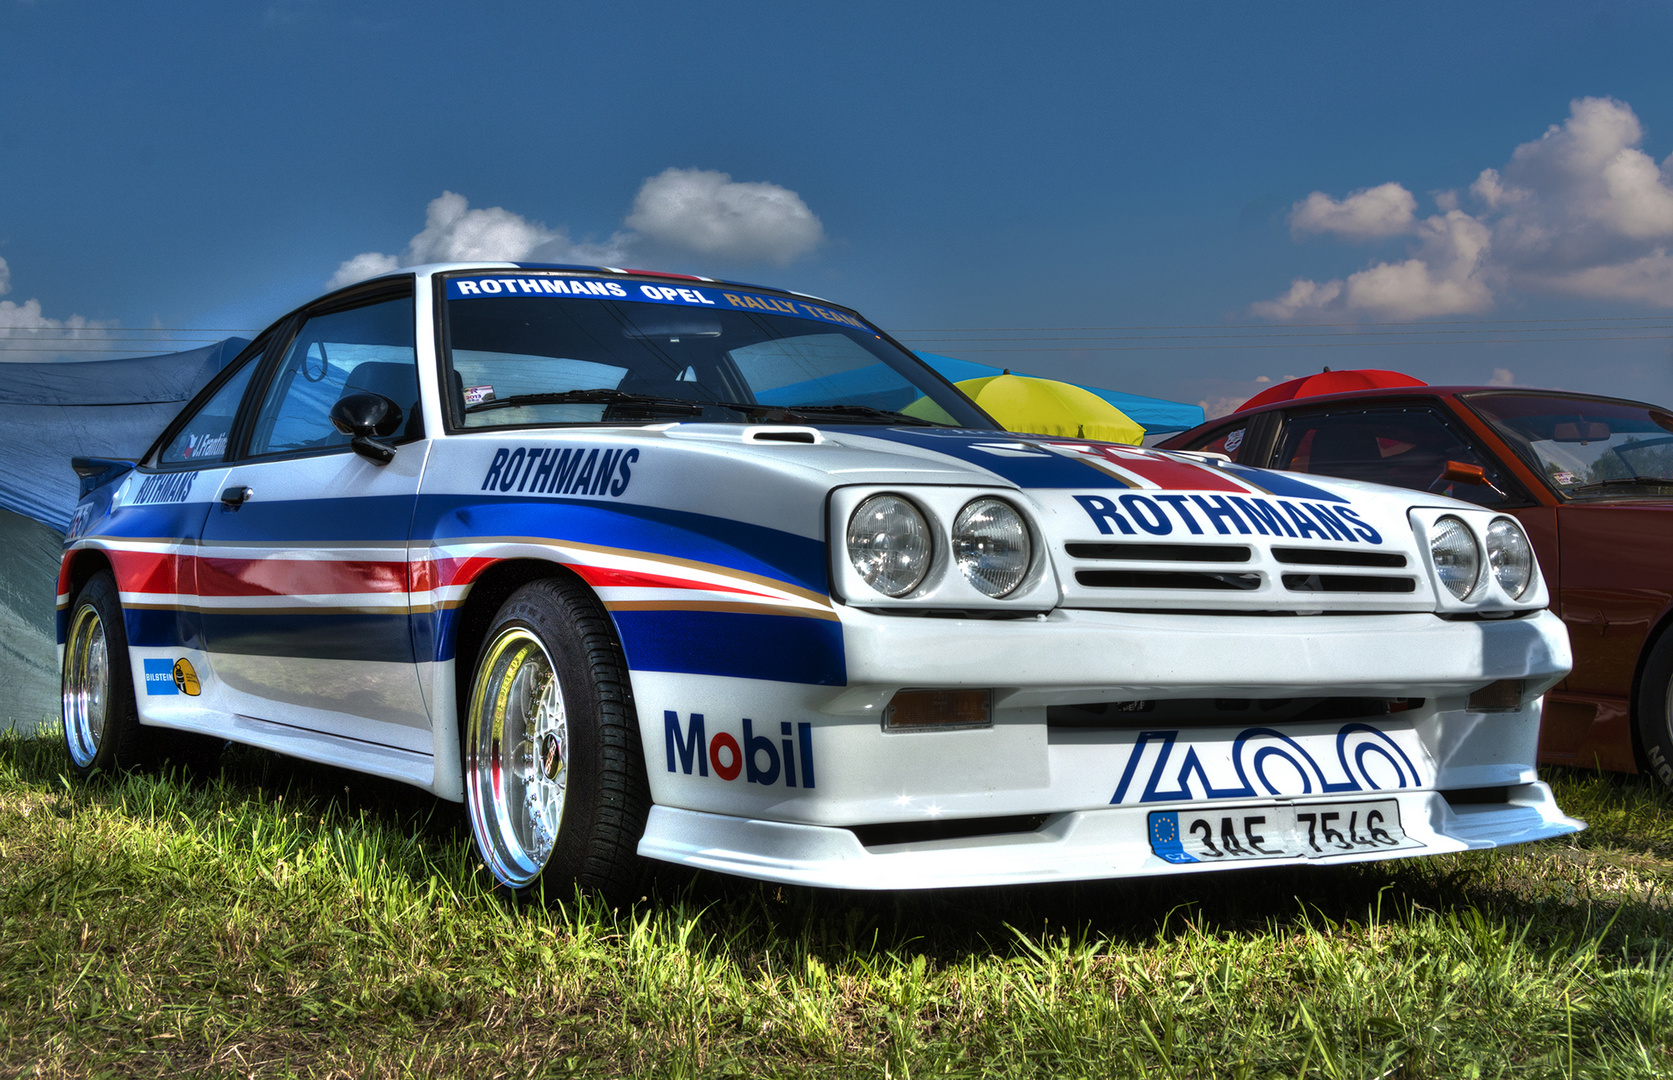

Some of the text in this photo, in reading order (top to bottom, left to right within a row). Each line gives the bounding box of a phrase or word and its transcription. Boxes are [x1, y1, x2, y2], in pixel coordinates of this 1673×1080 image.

[456, 280, 868, 331] ROTHMANS OPEL RALLY TEAM
[132, 471, 200, 505] ROTHMANS
[481, 446, 640, 498] ROTHMANS
[1072, 494, 1384, 545] ROTHMANS
[145, 673, 174, 682] BILSTEIN
[663, 709, 817, 790] Mobil
[1165, 852, 1192, 862] CZ
[1189, 809, 1400, 858] 3AE 7546
